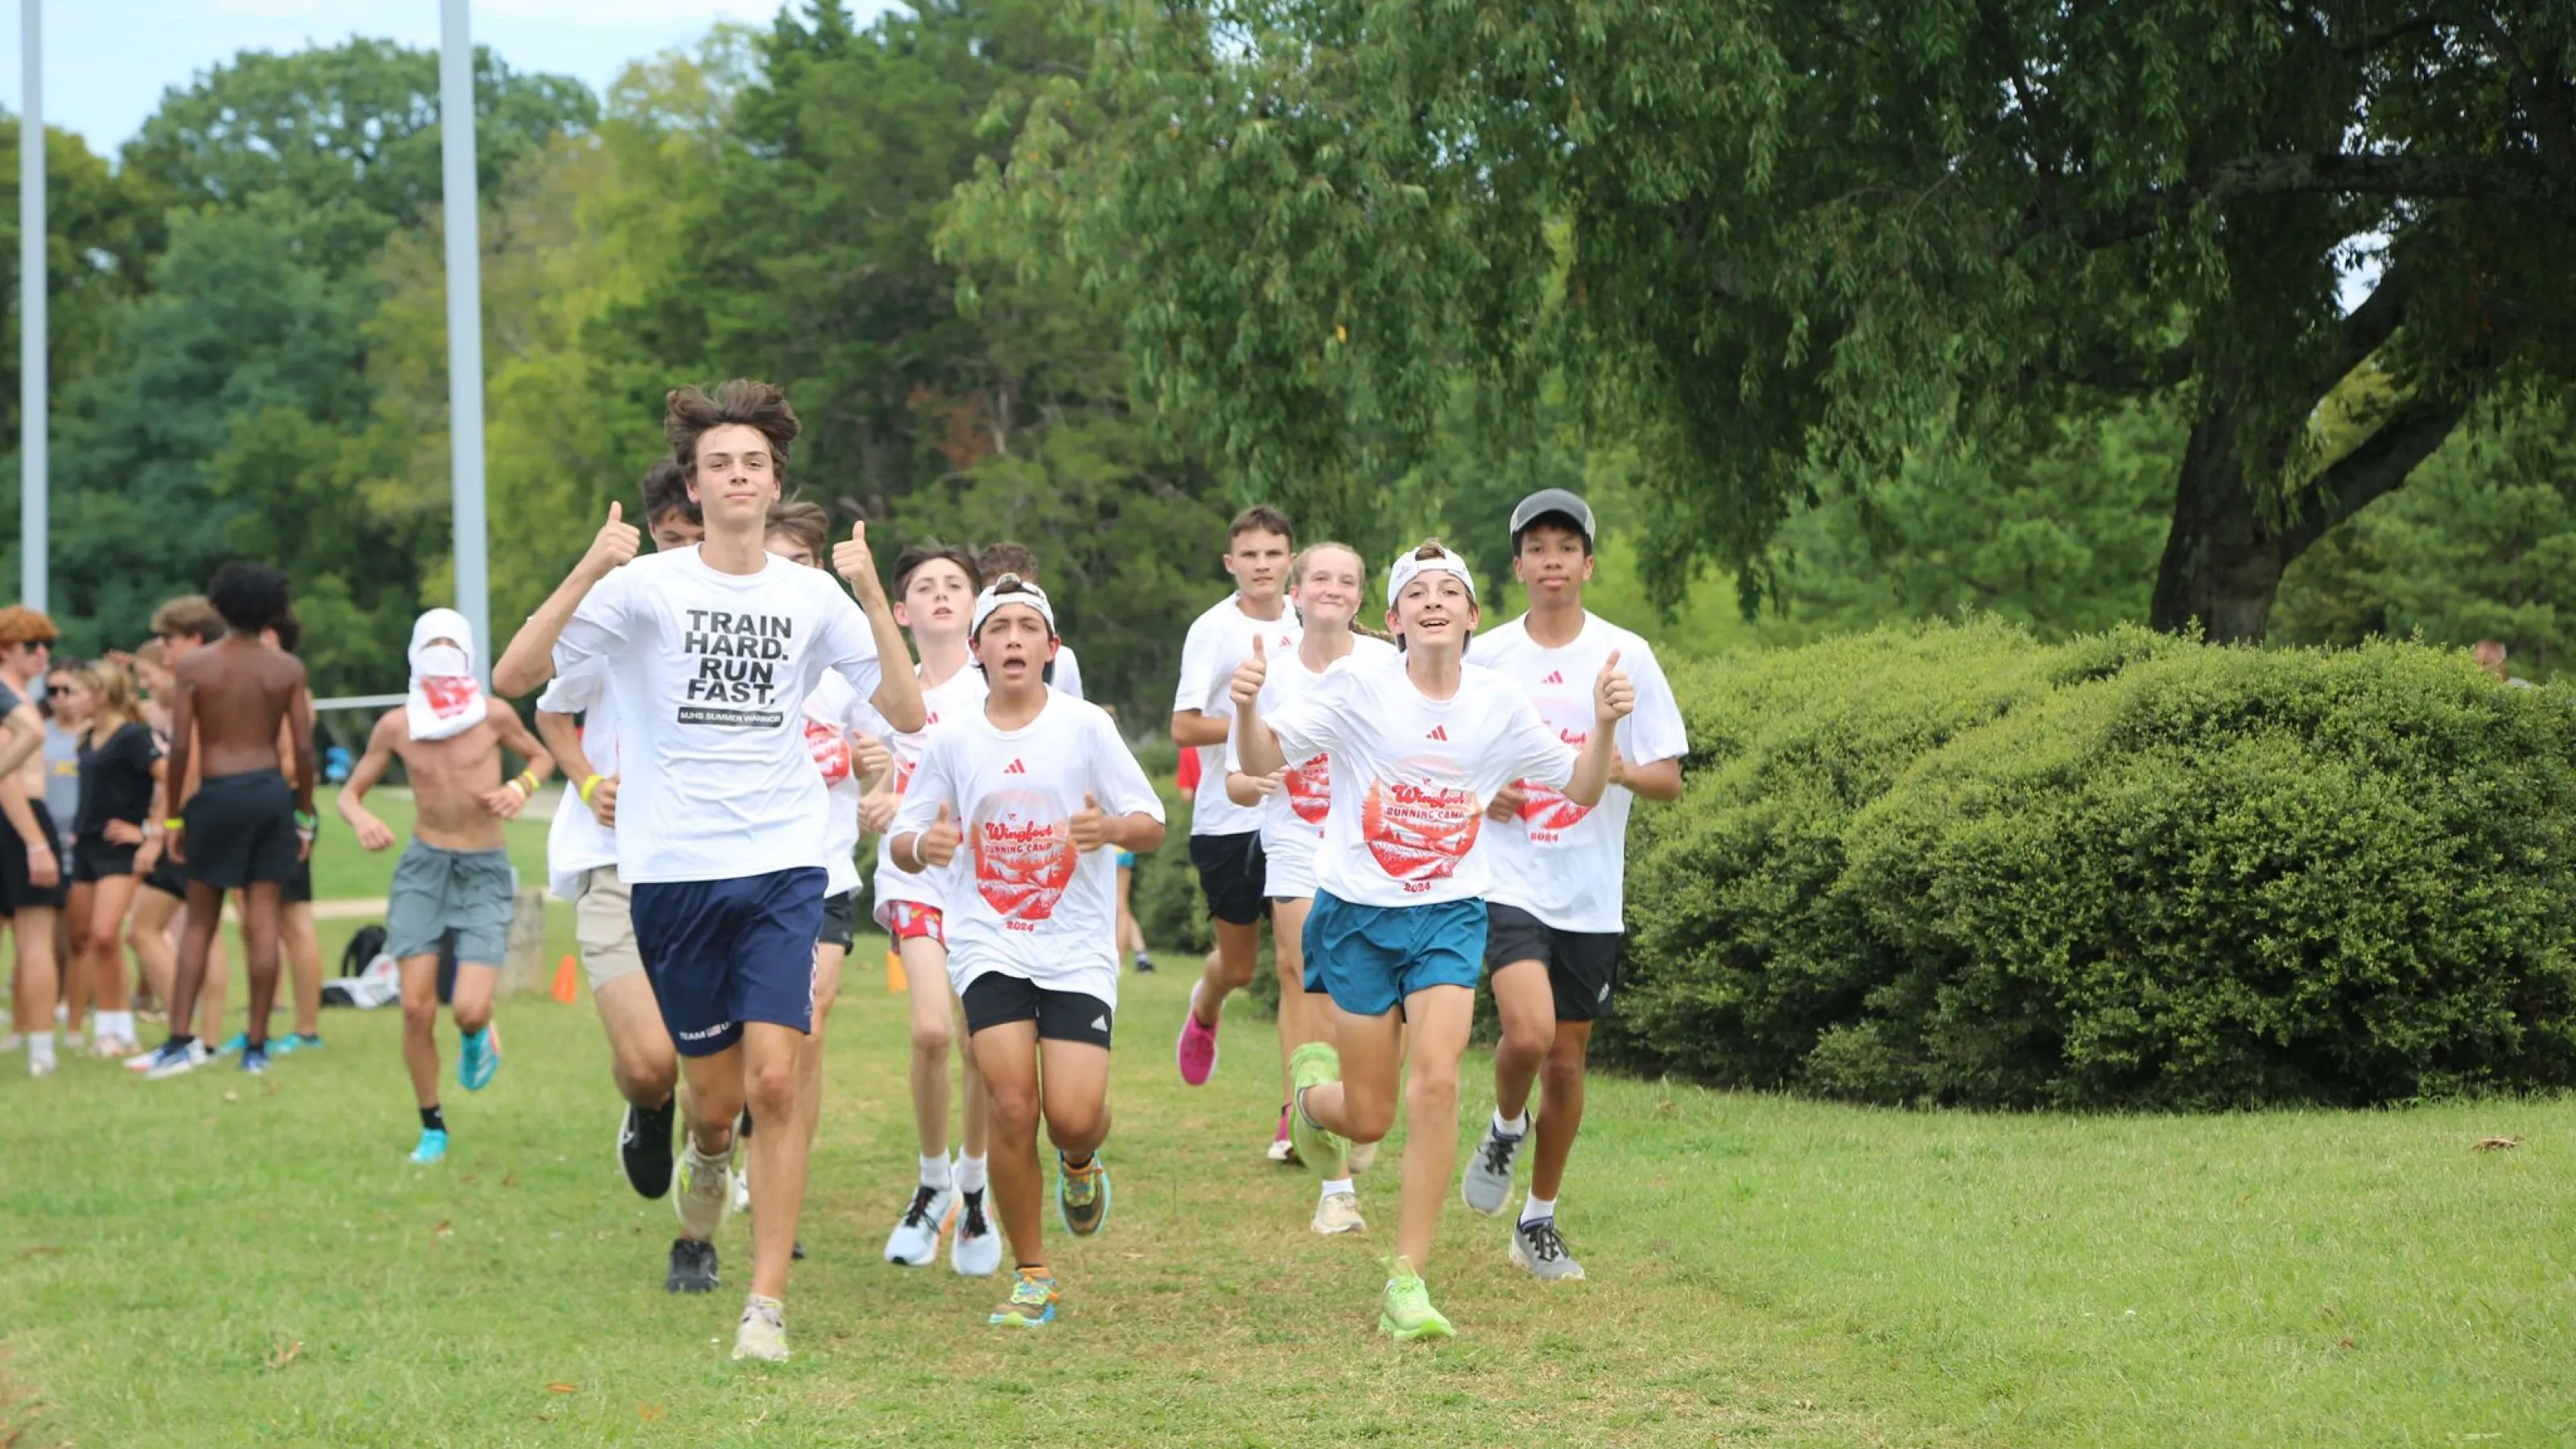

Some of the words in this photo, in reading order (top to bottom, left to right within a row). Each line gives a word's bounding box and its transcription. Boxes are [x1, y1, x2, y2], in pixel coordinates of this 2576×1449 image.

[686, 609, 791, 638] TRAIN
[684, 632, 788, 660] HARD.
[699, 657, 773, 684] RUN
[687, 679, 775, 704] FAST.
[1386, 807, 1435, 819] RUNNING
[985, 820, 1053, 842] Wingfoot
[1026, 842, 1052, 853] CAMP
[1403, 881, 1430, 893] 2024
[1006, 920, 1034, 933] 2024
